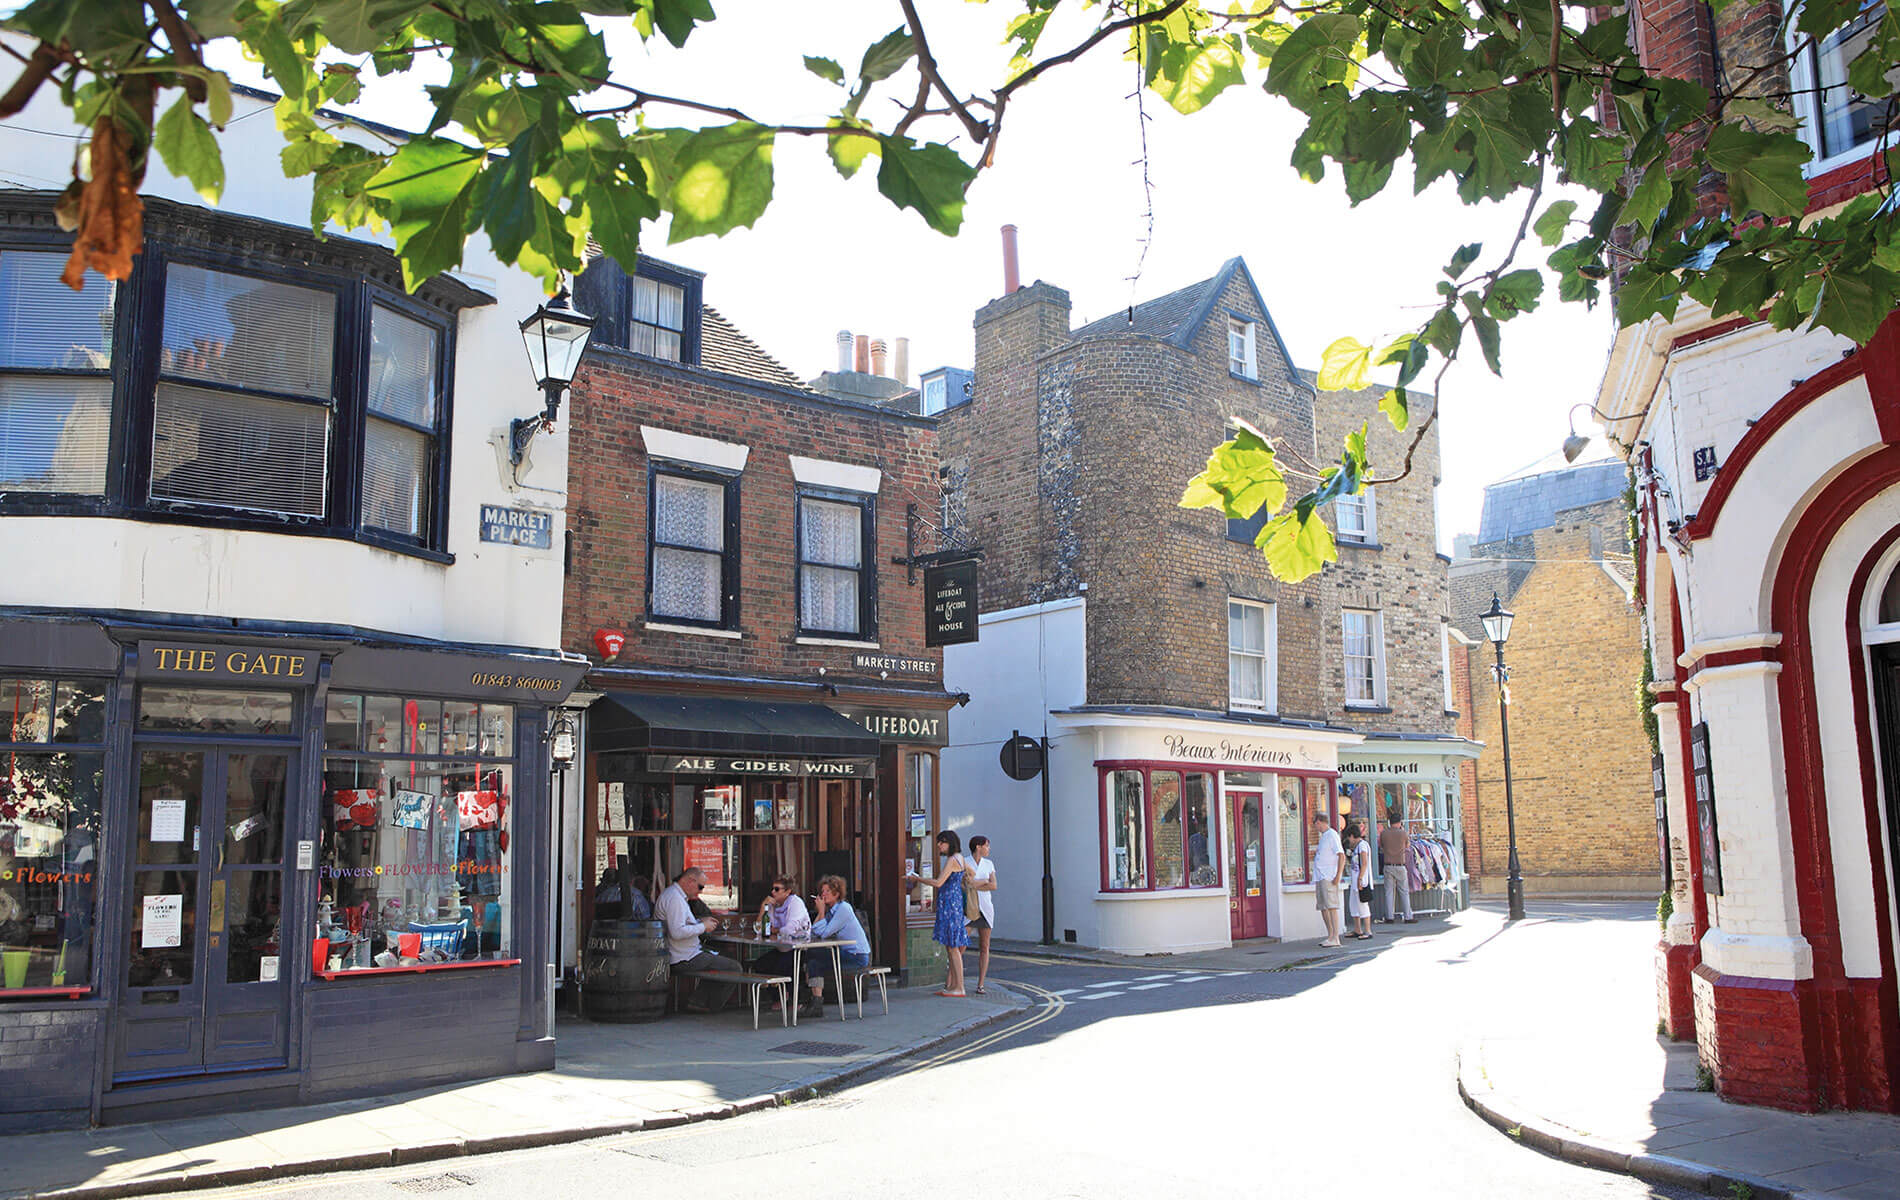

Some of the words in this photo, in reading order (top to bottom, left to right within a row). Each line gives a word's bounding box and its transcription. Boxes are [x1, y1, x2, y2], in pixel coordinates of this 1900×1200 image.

[485, 508, 547, 530] MARKET
[491, 525, 537, 545] PLACE
[937, 588, 962, 599] LIFEBOAT
[936, 604, 944, 612] ALE
[953, 601, 966, 609] CIDER
[939, 622, 963, 632] HOUSE
[153, 648, 217, 672] THE
[226, 652, 305, 677] GATE
[856, 655, 896, 669] MARKET
[900, 660, 936, 672] STREET
[472, 672, 512, 688] 01843
[515, 676, 562, 691] 860003
[865, 715, 939, 736] LIFEBOAT
[1163, 734, 1216, 760] Beaux
[1220, 738, 1293, 765] Intérieurs
[675, 759, 717, 770] ALE
[730, 761, 792, 773] CIDER
[804, 763, 855, 774] WINE
[1337, 762, 1376, 773] adam
[16, 866, 92, 883] Flowers
[319, 864, 373, 879] Flowers
[384, 862, 449, 876] FLOWERS
[458, 860, 509, 875] Flowers
